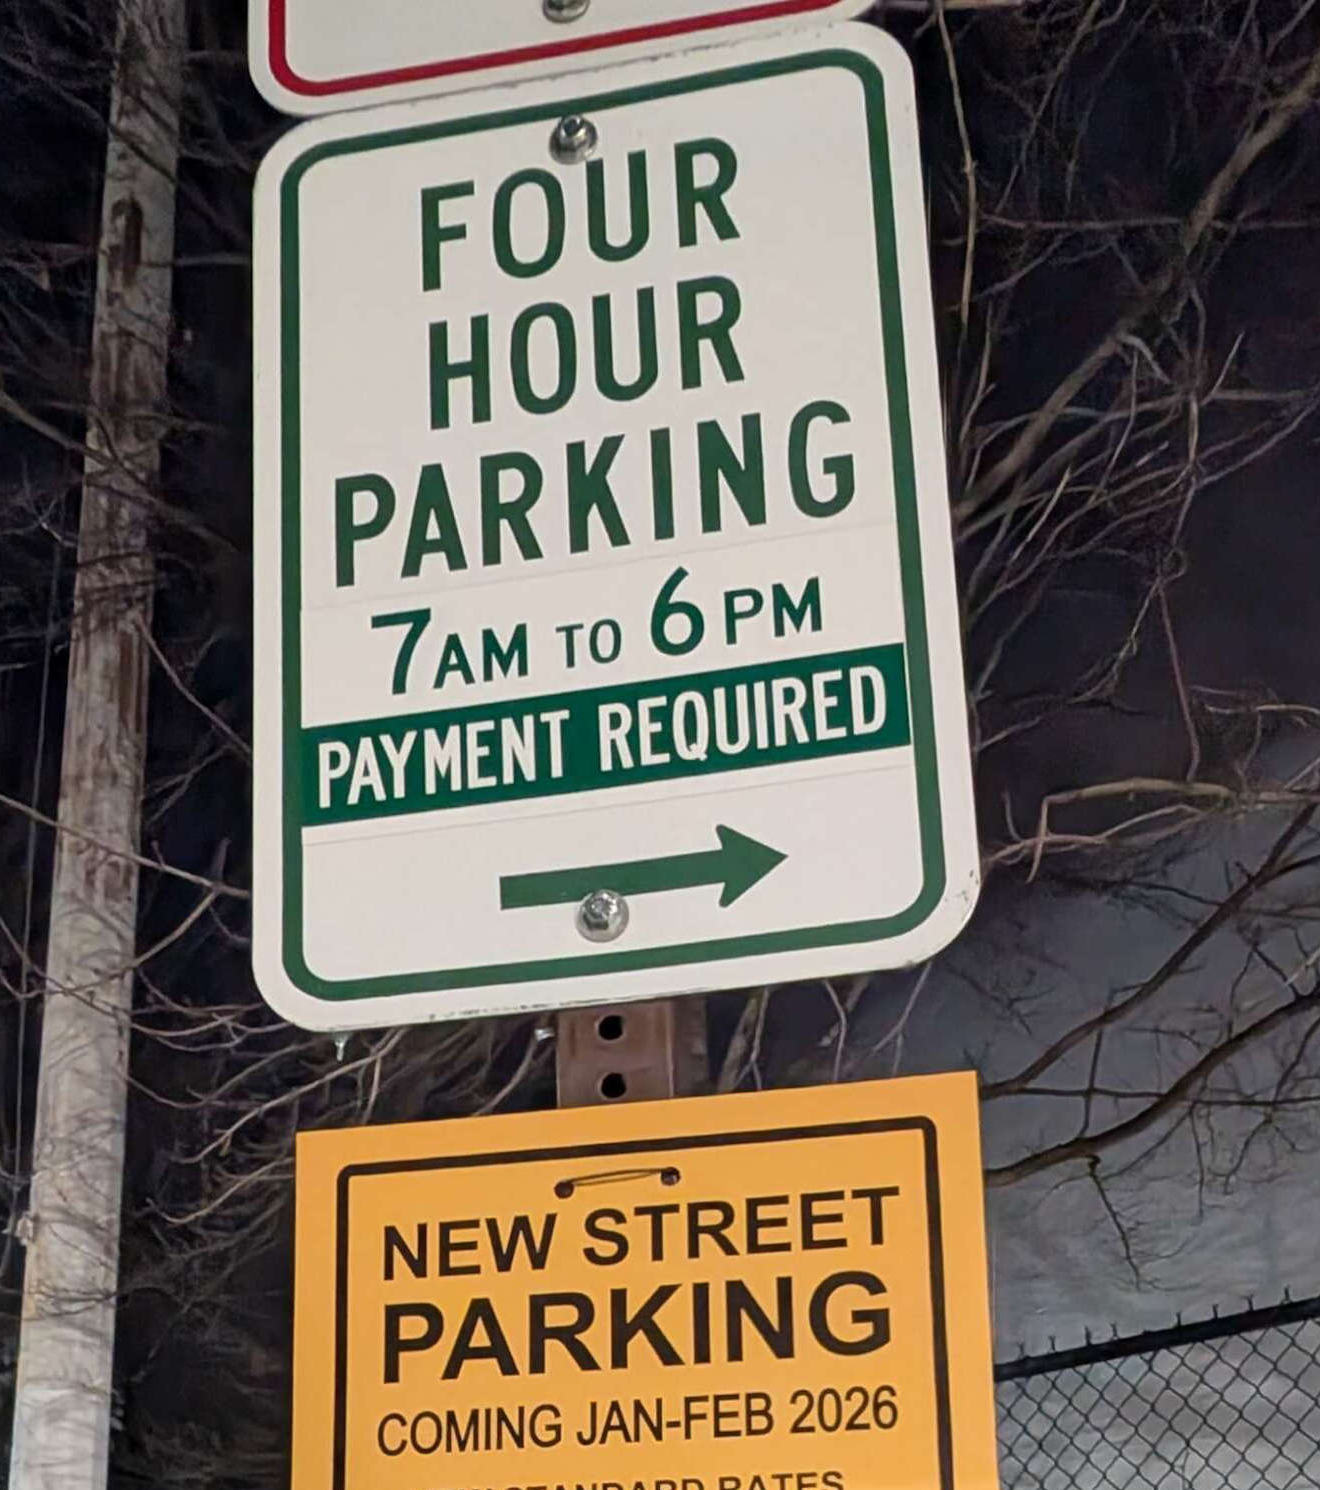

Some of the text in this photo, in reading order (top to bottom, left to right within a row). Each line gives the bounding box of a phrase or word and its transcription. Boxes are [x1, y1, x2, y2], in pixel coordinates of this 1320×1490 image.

[420, 137, 741, 292] FOUR
[428, 275, 745, 431] HOUR
[334, 400, 855, 588] PARKING
[555, 618, 622, 669] TO
[318, 665, 887, 809] PAYMENT REQUIRED
[383, 1185, 900, 1281] NEW STREET
[383, 1270, 891, 1385] PARKING
[377, 1384, 899, 1457] COMING JAN-FEB 2026
